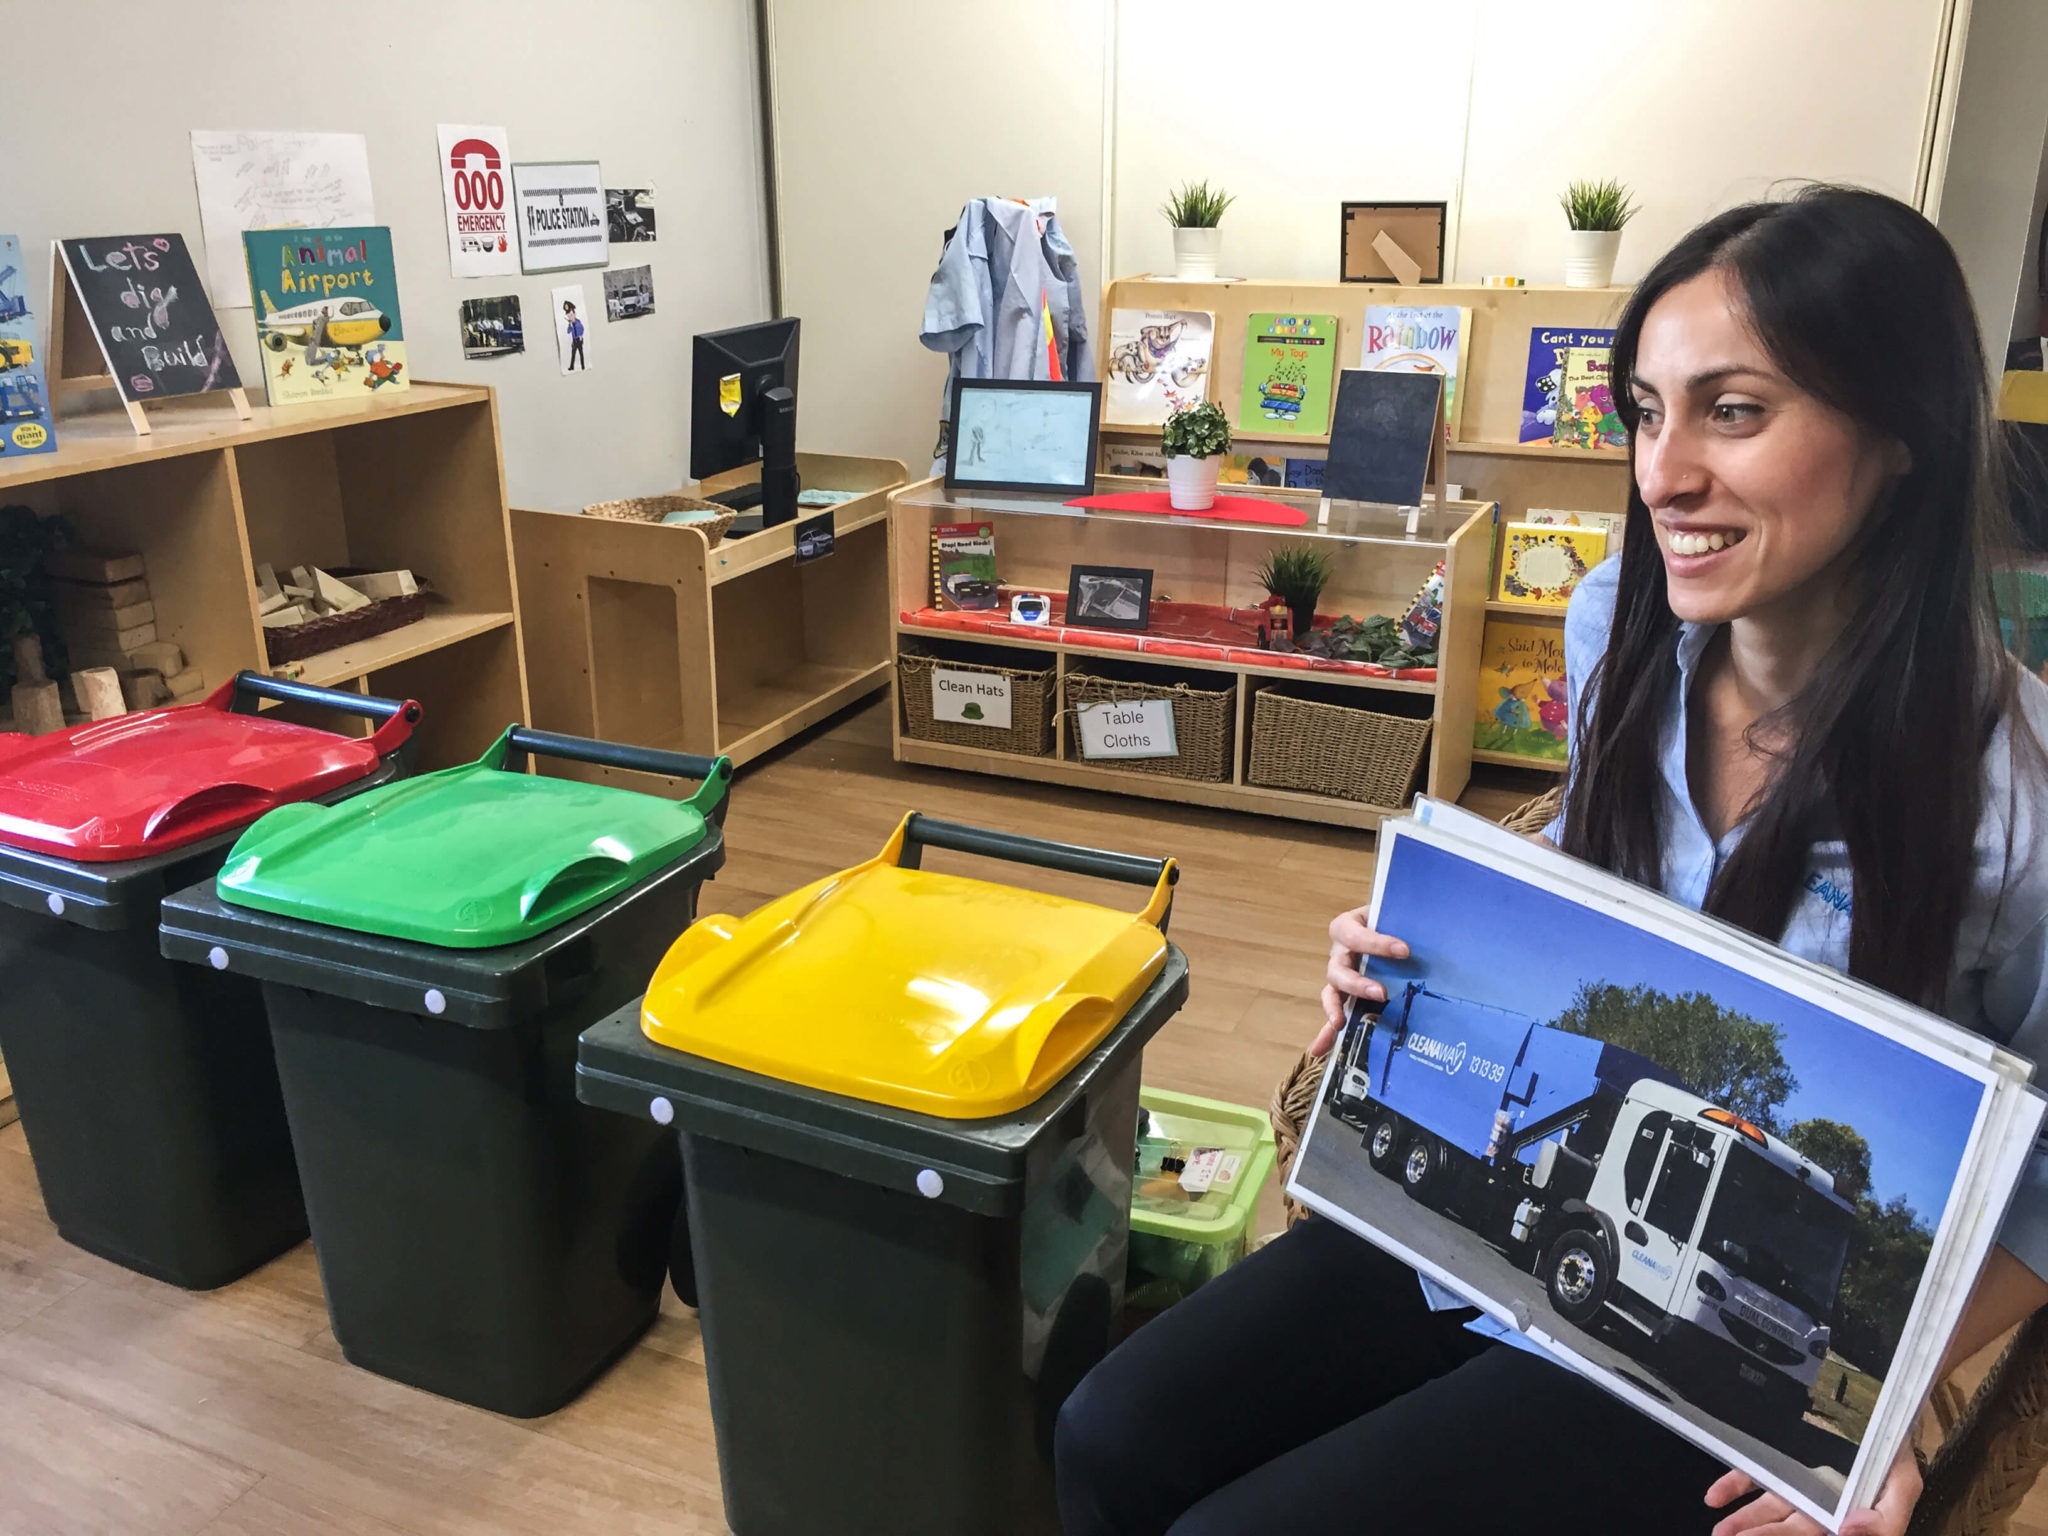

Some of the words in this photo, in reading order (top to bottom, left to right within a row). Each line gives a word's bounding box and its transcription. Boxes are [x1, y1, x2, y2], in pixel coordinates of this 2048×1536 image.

[454, 170, 504, 211] 000
[457, 214, 506, 232] EMERGENCY
[536, 208, 562, 231] POLICE
[562, 206, 590, 230] STATION
[281, 237, 367, 268] Animal
[281, 268, 375, 297] Airport
[120, 276, 178, 330] dig
[111, 312, 158, 342] and
[1541, 332, 1574, 344] Can't
[1580, 334, 1605, 347] you
[141, 334, 209, 372] Build
[1271, 348, 1284, 361] My
[1290, 348, 1308, 362] Toys
[1508, 638, 1535, 653] Said
[938, 679, 973, 694] Clean
[976, 683, 1004, 697] Hats
[1102, 711, 1144, 725] Table
[1103, 734, 1151, 748] Cloths
[1804, 872, 1852, 918] EANA
[1407, 1032, 1463, 1067] CLEANAWAY
